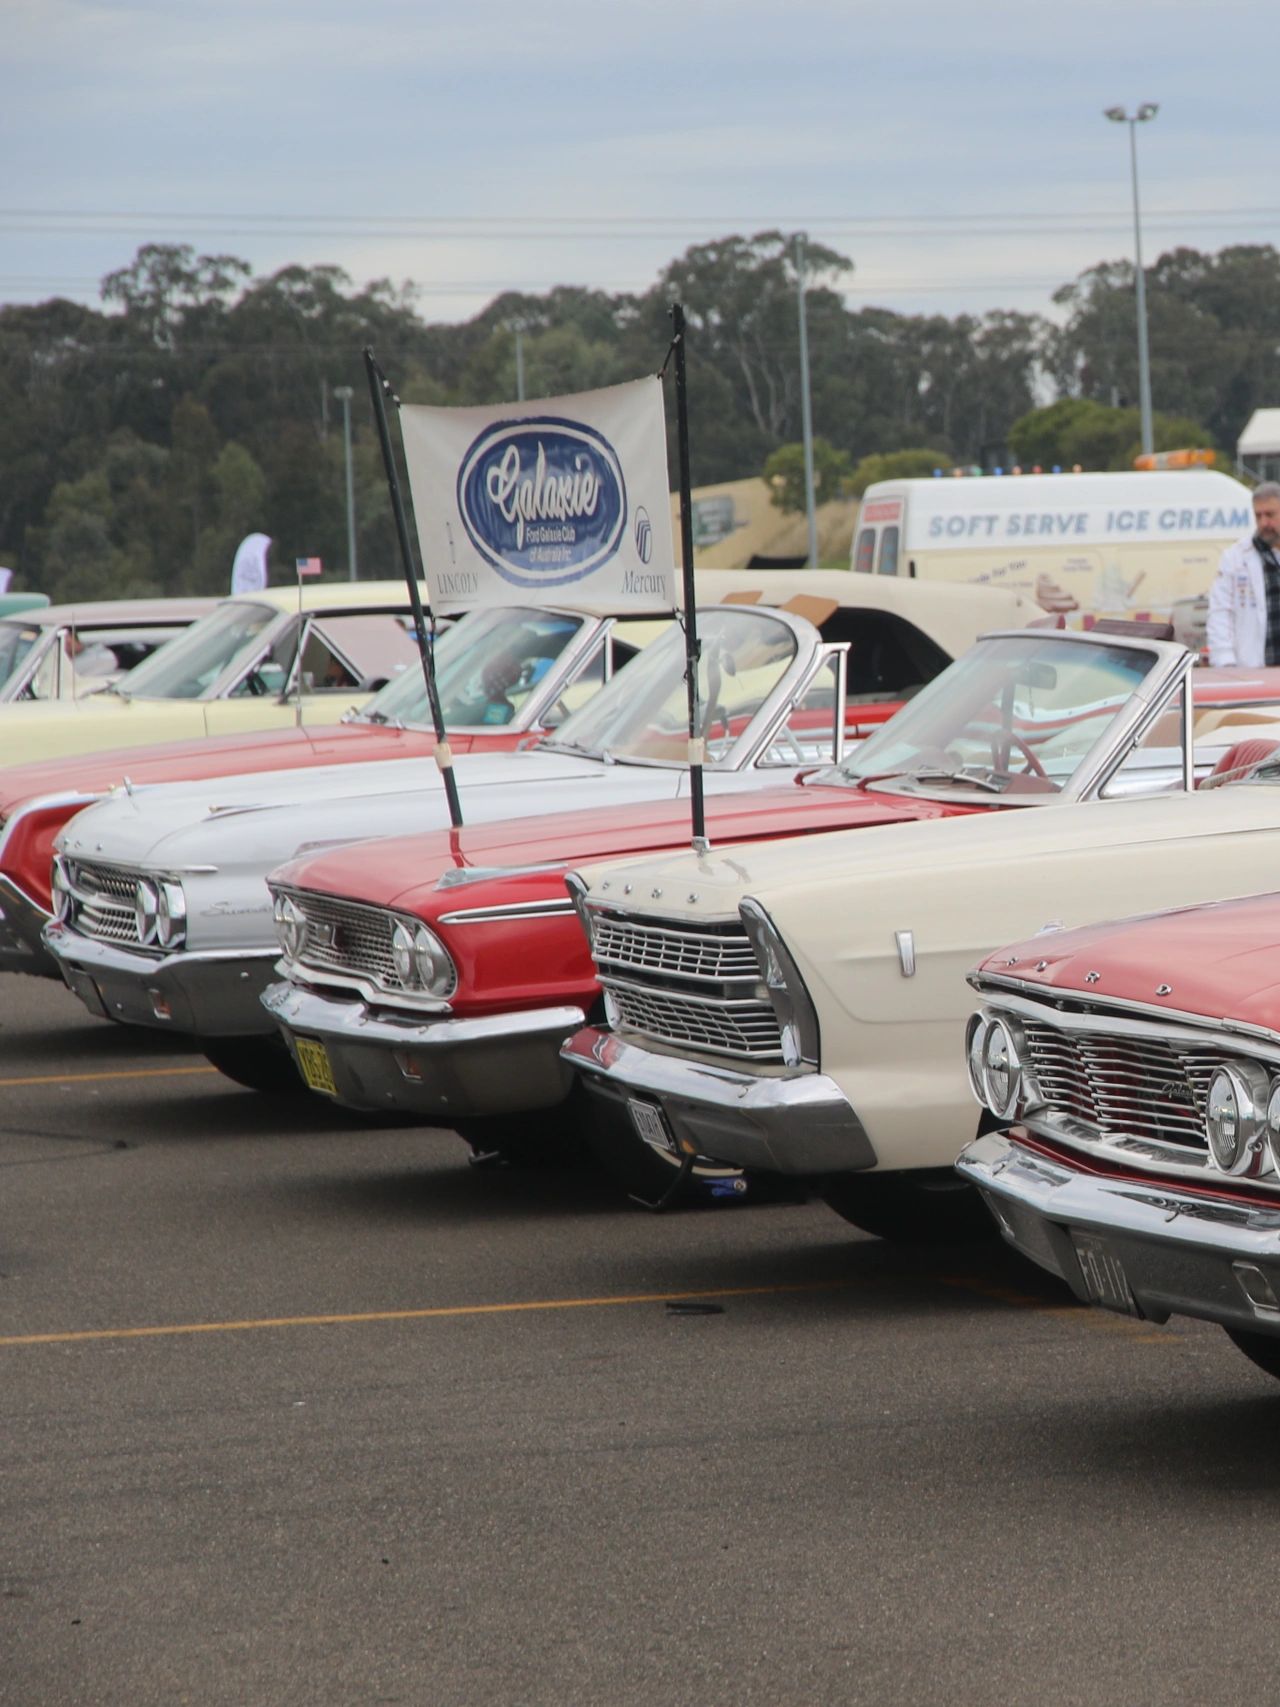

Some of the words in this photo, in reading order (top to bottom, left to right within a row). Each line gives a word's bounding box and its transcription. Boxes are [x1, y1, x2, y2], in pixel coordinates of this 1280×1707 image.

[486, 441, 600, 550] Galaxie
[526, 526, 539, 544] Ford
[562, 525, 576, 543] Club
[929, 515, 998, 537] SOFT
[1005, 512, 1089, 535] SERVE
[1106, 510, 1150, 531] ICE
[1158, 507, 1250, 530] CREAM
[437, 573, 478, 594] LINCOLN
[620, 570, 667, 598] Mercury
